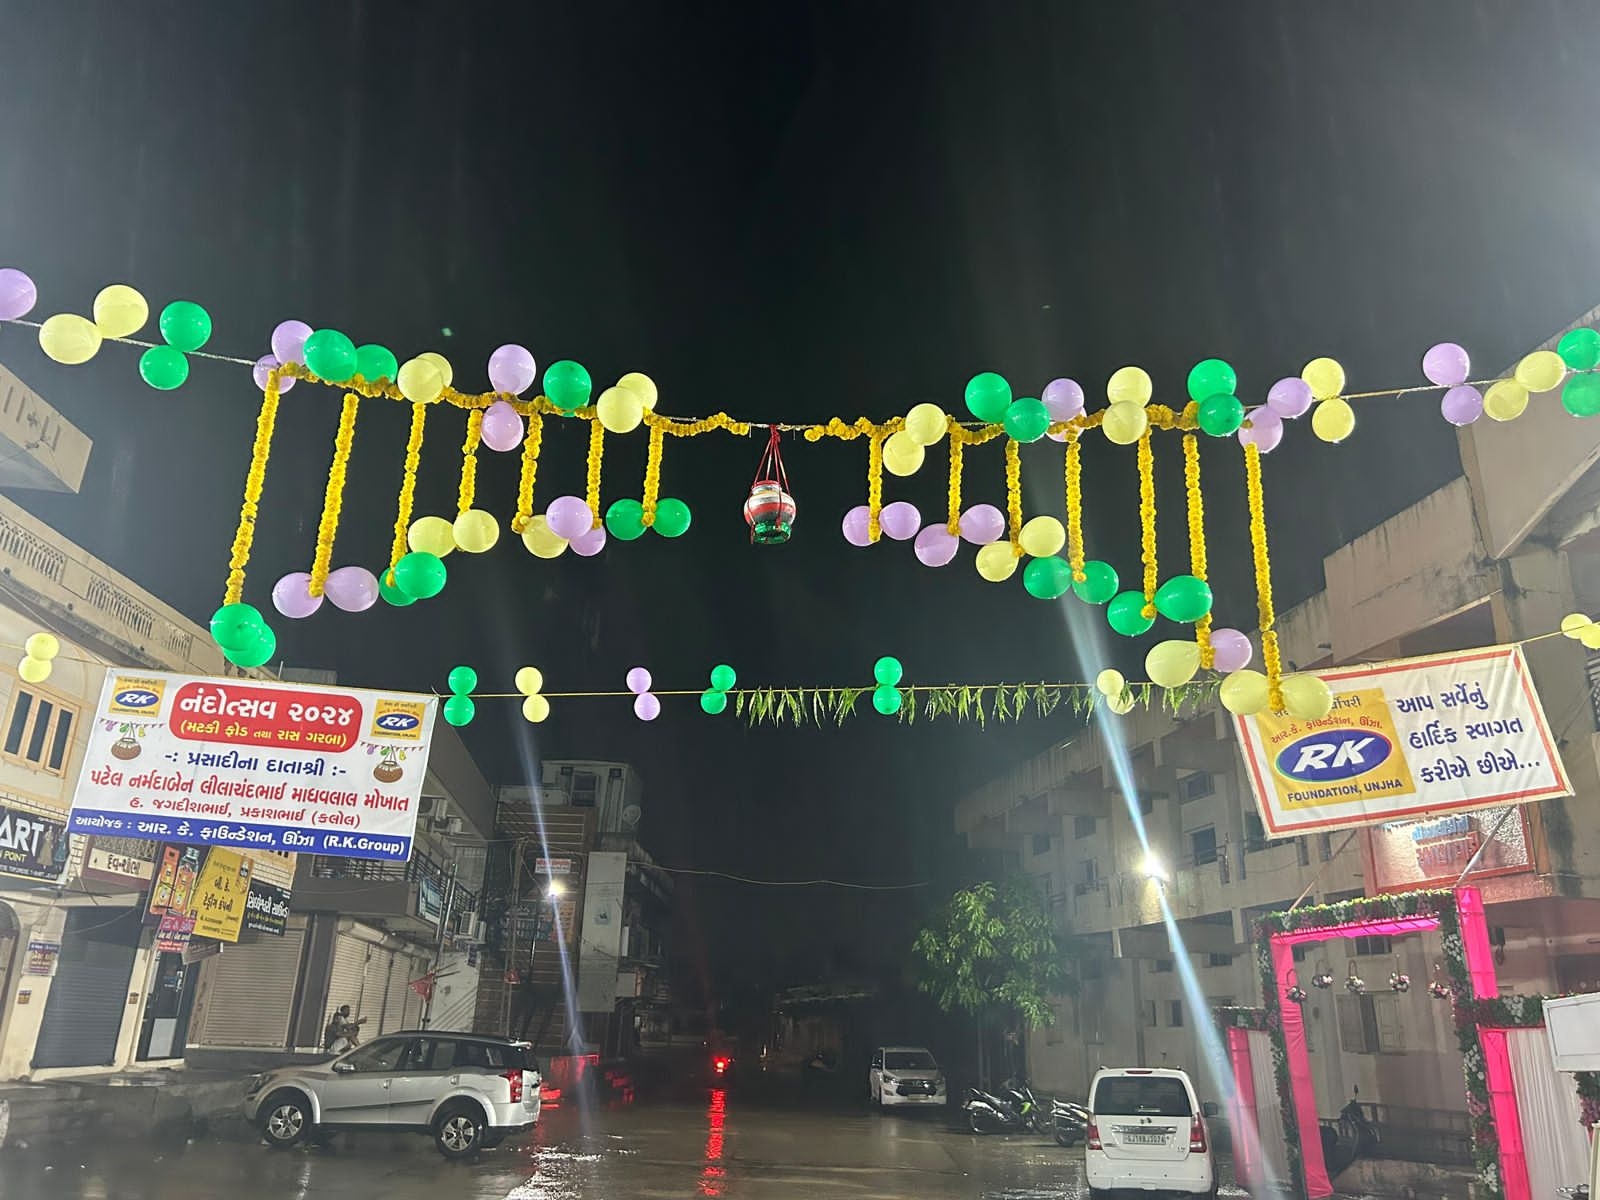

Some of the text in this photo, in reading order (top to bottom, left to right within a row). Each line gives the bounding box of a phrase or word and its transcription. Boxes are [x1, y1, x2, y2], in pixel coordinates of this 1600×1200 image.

[120, 693, 154, 705] RK
[179, 688, 354, 726] નંદોત્સવ ૨૦૨૪
[1396, 694, 1434, 713] આપ
[180, 718, 348, 748] (મટકી ફોડ તથા રાસ ગરબા)
[380, 716, 416, 728] RK
[1409, 717, 1524, 749] હાર્દિક સ્વાગત
[187, 750, 258, 771] પ્રસાદીના
[266, 758, 325, 776] દાતાશ્રી
[1292, 737, 1376, 773] RK
[1420, 755, 1471, 783] કરીએ
[91, 765, 122, 787] પટેલ
[128, 769, 194, 793] નર્મદાબેન
[291, 787, 358, 807] માધવલાલ
[1287, 778, 1403, 803] FOUNDATION, UNJHA
[240, 803, 306, 822] પ્રકાશભાઈ
[312, 810, 361, 829] (કલોલ)
[75, 813, 123, 829] આયોજક
[137, 821, 171, 835] આર.
[200, 827, 277, 846] ફાઉન્ડેશન,
[282, 830, 314, 847] ઊંઝા
[323, 834, 405, 856] (R.K.Group)
[4, 850, 27, 863] POINT
